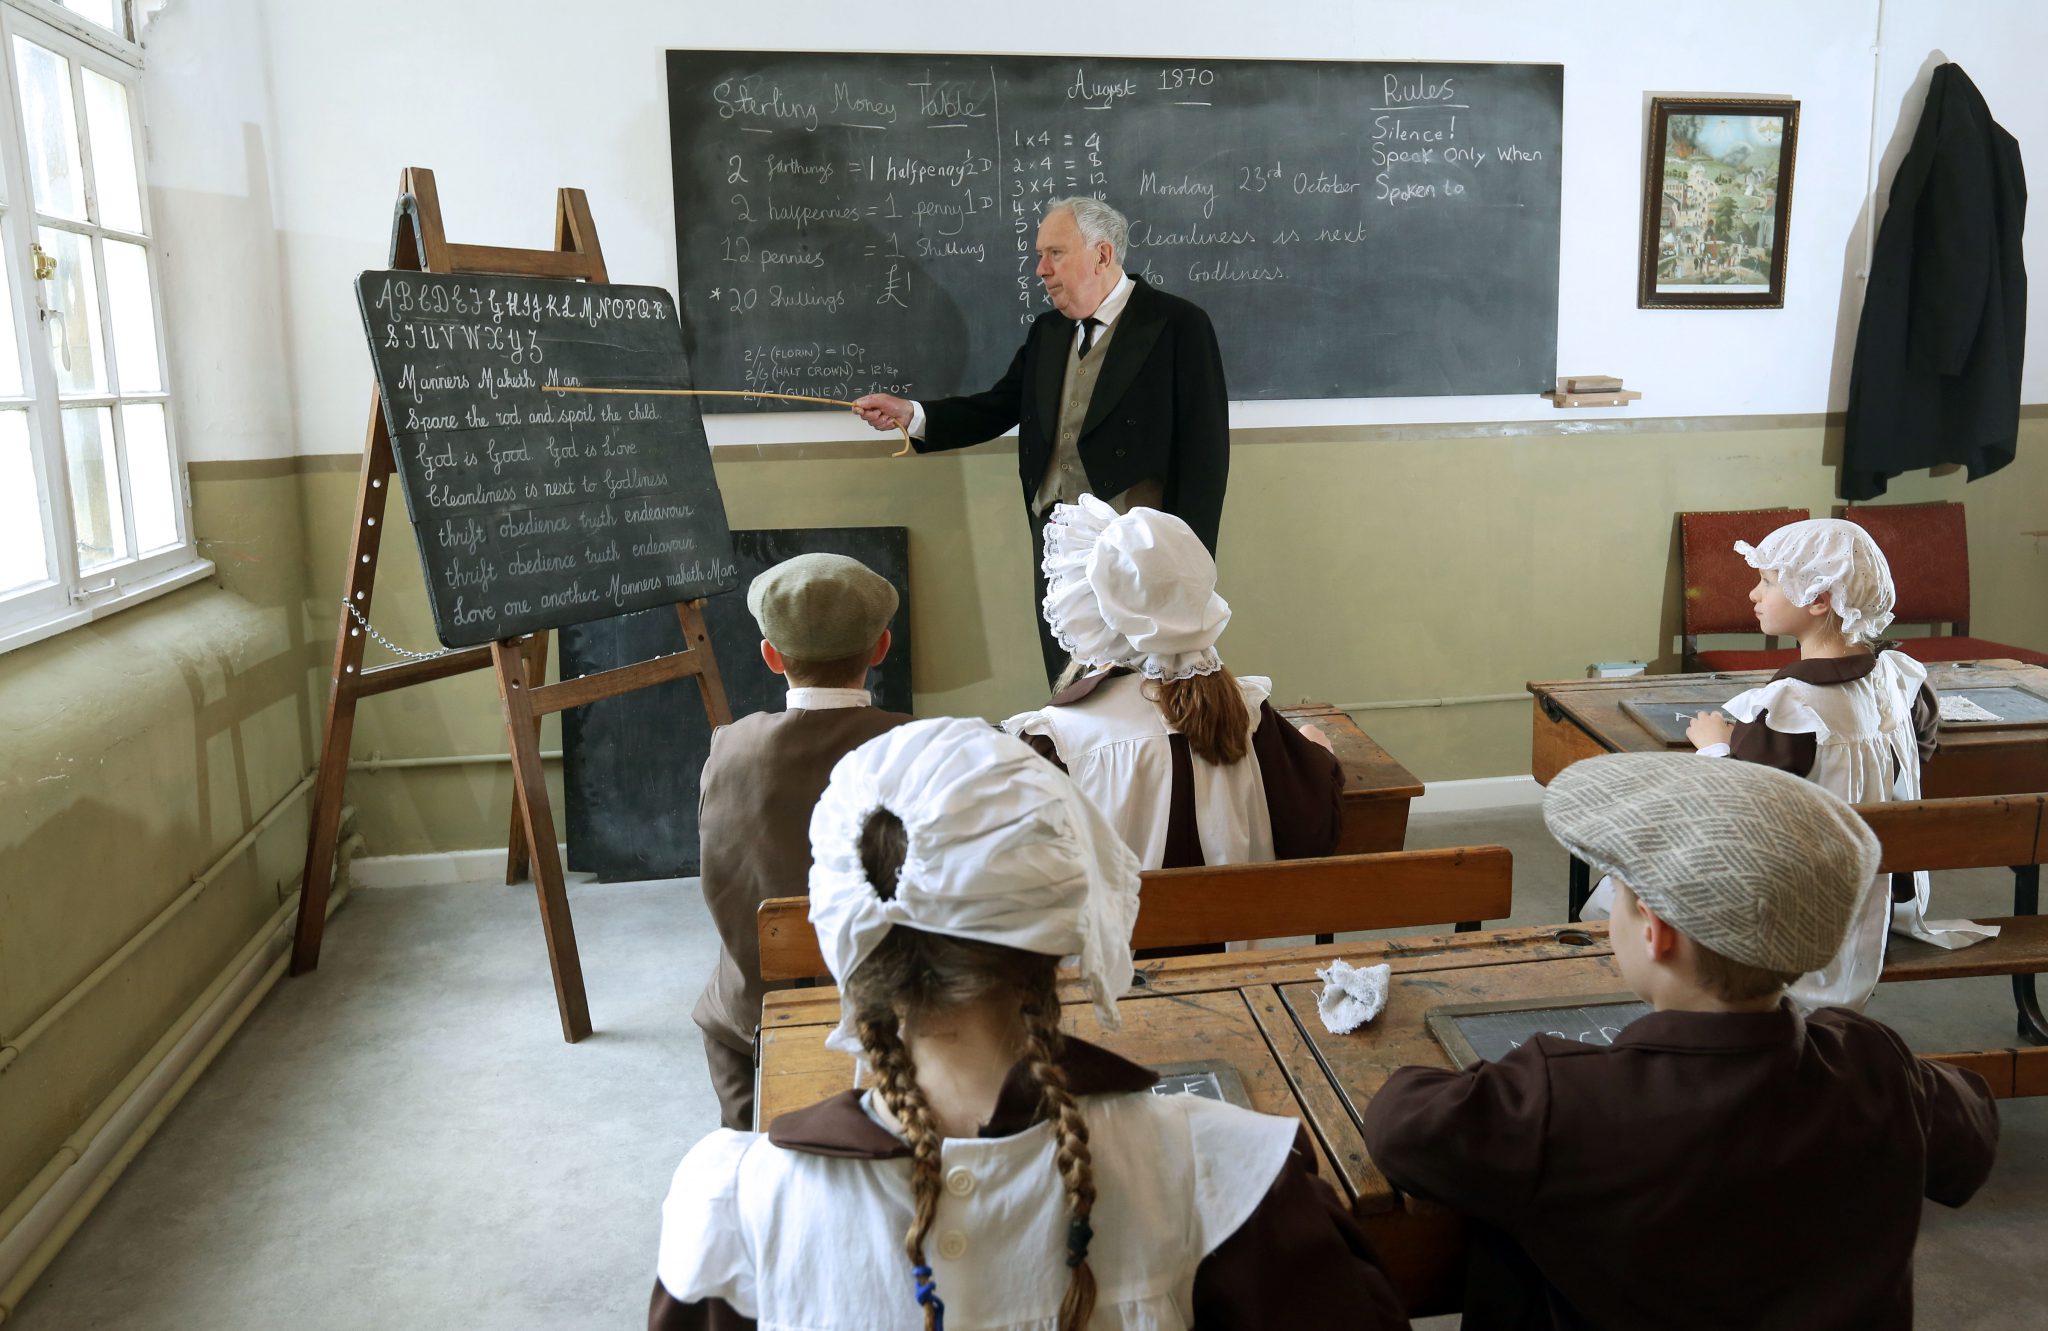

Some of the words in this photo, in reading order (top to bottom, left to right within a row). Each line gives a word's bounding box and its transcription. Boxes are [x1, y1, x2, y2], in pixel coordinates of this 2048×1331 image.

[714, 78, 818, 132] Sterling
[831, 82, 897, 123] Money
[908, 69, 987, 117] Table
[1068, 68, 1136, 106] August
[1157, 68, 1214, 91] 1870
[1383, 73, 1455, 106] Rules
[1038, 130, 1051, 146] 4
[1084, 132, 1100, 152] 4
[1371, 141, 1433, 171] Speak
[1444, 147, 1486, 168] Only
[728, 155, 748, 183] 2
[767, 154, 834, 184] farthings
[887, 157, 966, 187] halfpenny
[1013, 158, 1025, 173] 2
[1040, 156, 1053, 171] 4
[1088, 152, 1102, 167] 8
[1011, 180, 1025, 197] 3
[1042, 176, 1056, 194] 4
[1090, 172, 1107, 184] 12
[1140, 168, 1219, 219] Monday
[1293, 171, 1360, 195] October
[1375, 173, 1436, 206] Spoken
[1443, 178, 1465, 196] to
[731, 194, 758, 222] 2
[768, 194, 860, 230] halfpennies
[912, 200, 965, 235] penny
[1012, 199, 1025, 216] 4
[1014, 216, 1028, 234] 5
[1127, 220, 1256, 248] Cleanliness
[1273, 229, 1301, 246] is
[1315, 220, 1367, 244] next
[720, 236, 751, 262] 12
[761, 249, 825, 273] pennies
[916, 237, 985, 263] Shilling
[1017, 236, 1028, 252] 6
[1018, 255, 1029, 273] 7
[1141, 259, 1164, 286] to
[1017, 275, 1030, 289] 8
[769, 285, 845, 314] Shillings
[1019, 291, 1030, 309] 9
[1020, 313, 1036, 325] 10
[842, 343, 866, 363] 10p
[398, 364, 470, 404] Manners
[478, 367, 536, 399] Maketh
[405, 408, 459, 440] Spare
[465, 404, 490, 428] the
[495, 404, 522, 425] rod
[528, 402, 555, 424] and
[557, 403, 596, 432] spoil
[601, 403, 622, 422] the
[416, 442, 458, 480] God
[463, 451, 478, 467] is
[546, 435, 579, 468] God
[584, 443, 597, 457] is
[426, 482, 516, 508] Cleanliness
[524, 482, 538, 498] is
[544, 478, 576, 497] next
[582, 475, 598, 493] to
[603, 467, 668, 499] Godliness
[438, 518, 487, 553] thrift
[499, 510, 570, 539] obedience
[578, 504, 618, 528] truth
[444, 559, 498, 593] thrift
[508, 548, 577, 577] obedience
[585, 540, 620, 563] truth
[453, 596, 497, 626] Love
[504, 600, 532, 616] one
[540, 580, 600, 608] another
[605, 573, 662, 607] Manners
[666, 560, 704, 587] maketh
